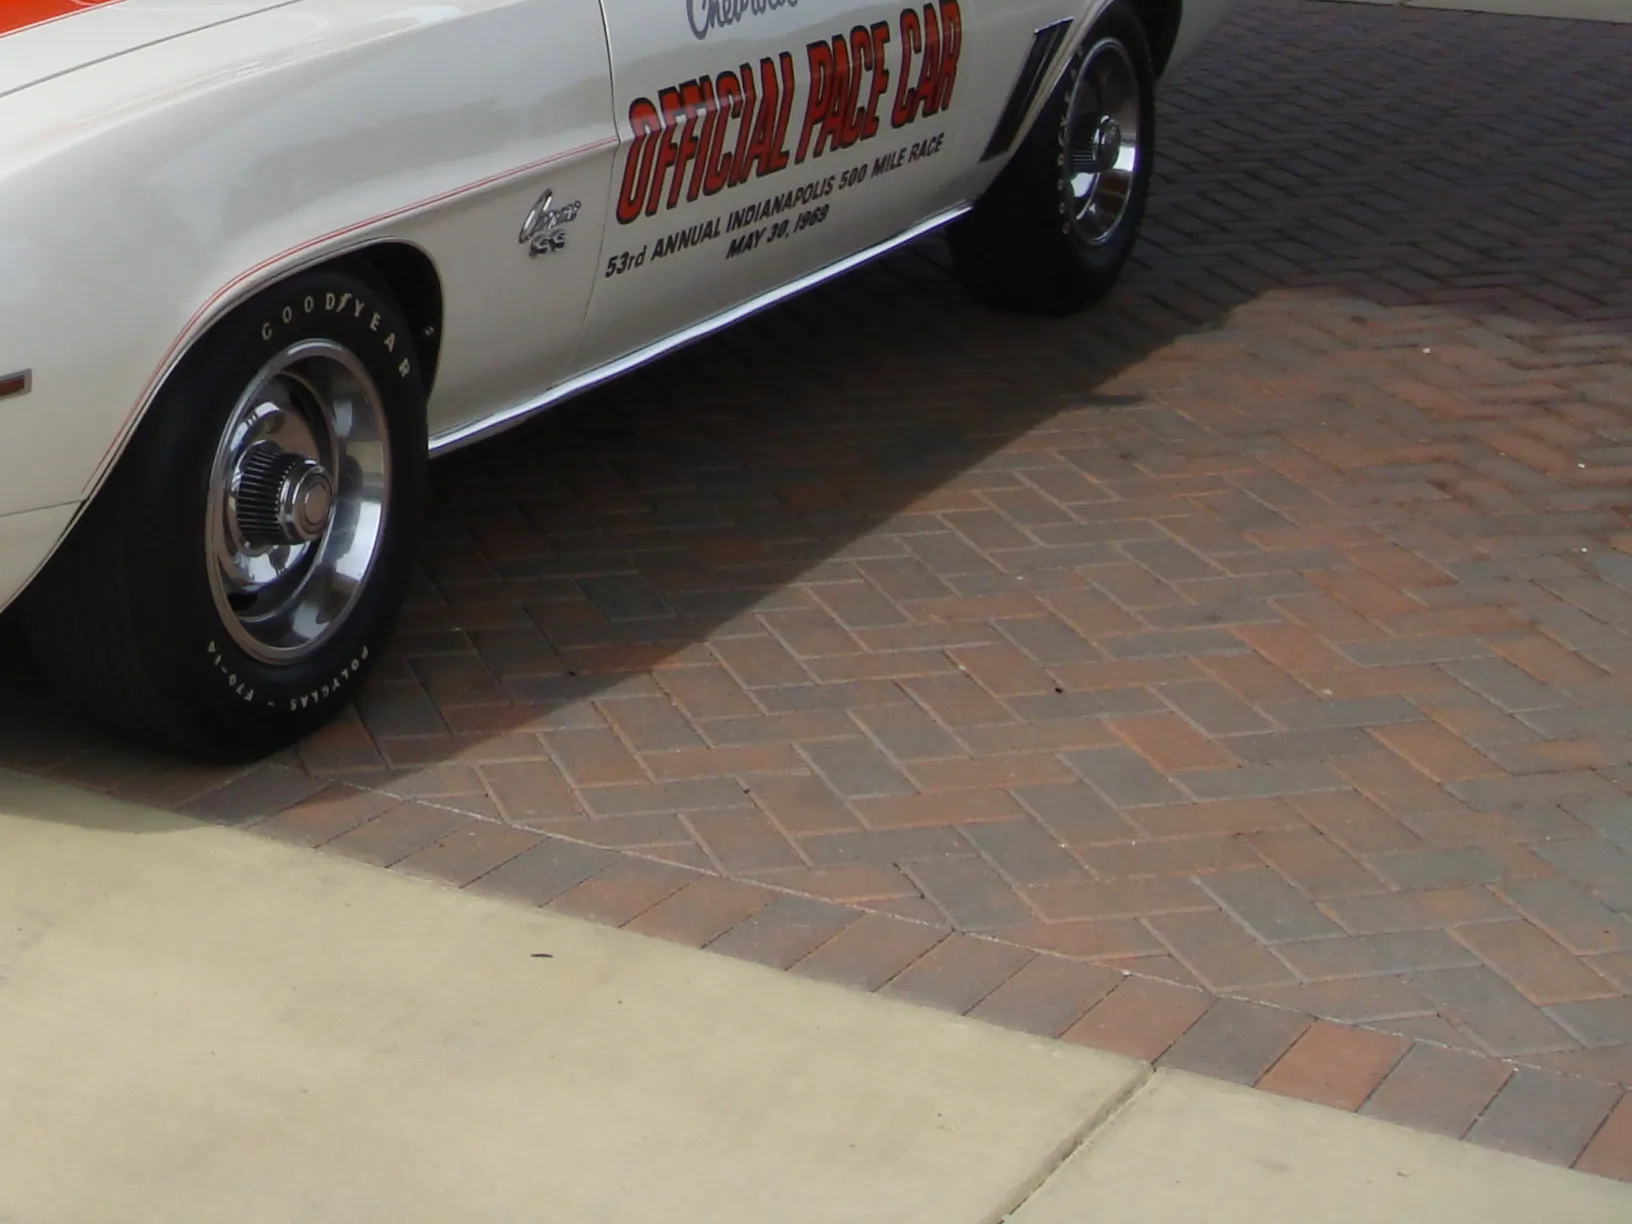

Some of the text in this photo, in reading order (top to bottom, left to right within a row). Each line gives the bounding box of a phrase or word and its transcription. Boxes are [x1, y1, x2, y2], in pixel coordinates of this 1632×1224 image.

[615, 51, 795, 226] OFFICIAL
[795, 20, 891, 165] PACE
[605, 133, 945, 278] 53rd ANNUAL INDIANAPOLIS 500 MILE RACE
[726, 228, 767, 260] MAY
[793, 204, 830, 233] 1969
[261, 291, 411, 378] GOODYEAR
[289, 645, 369, 711] POLYGLAS
